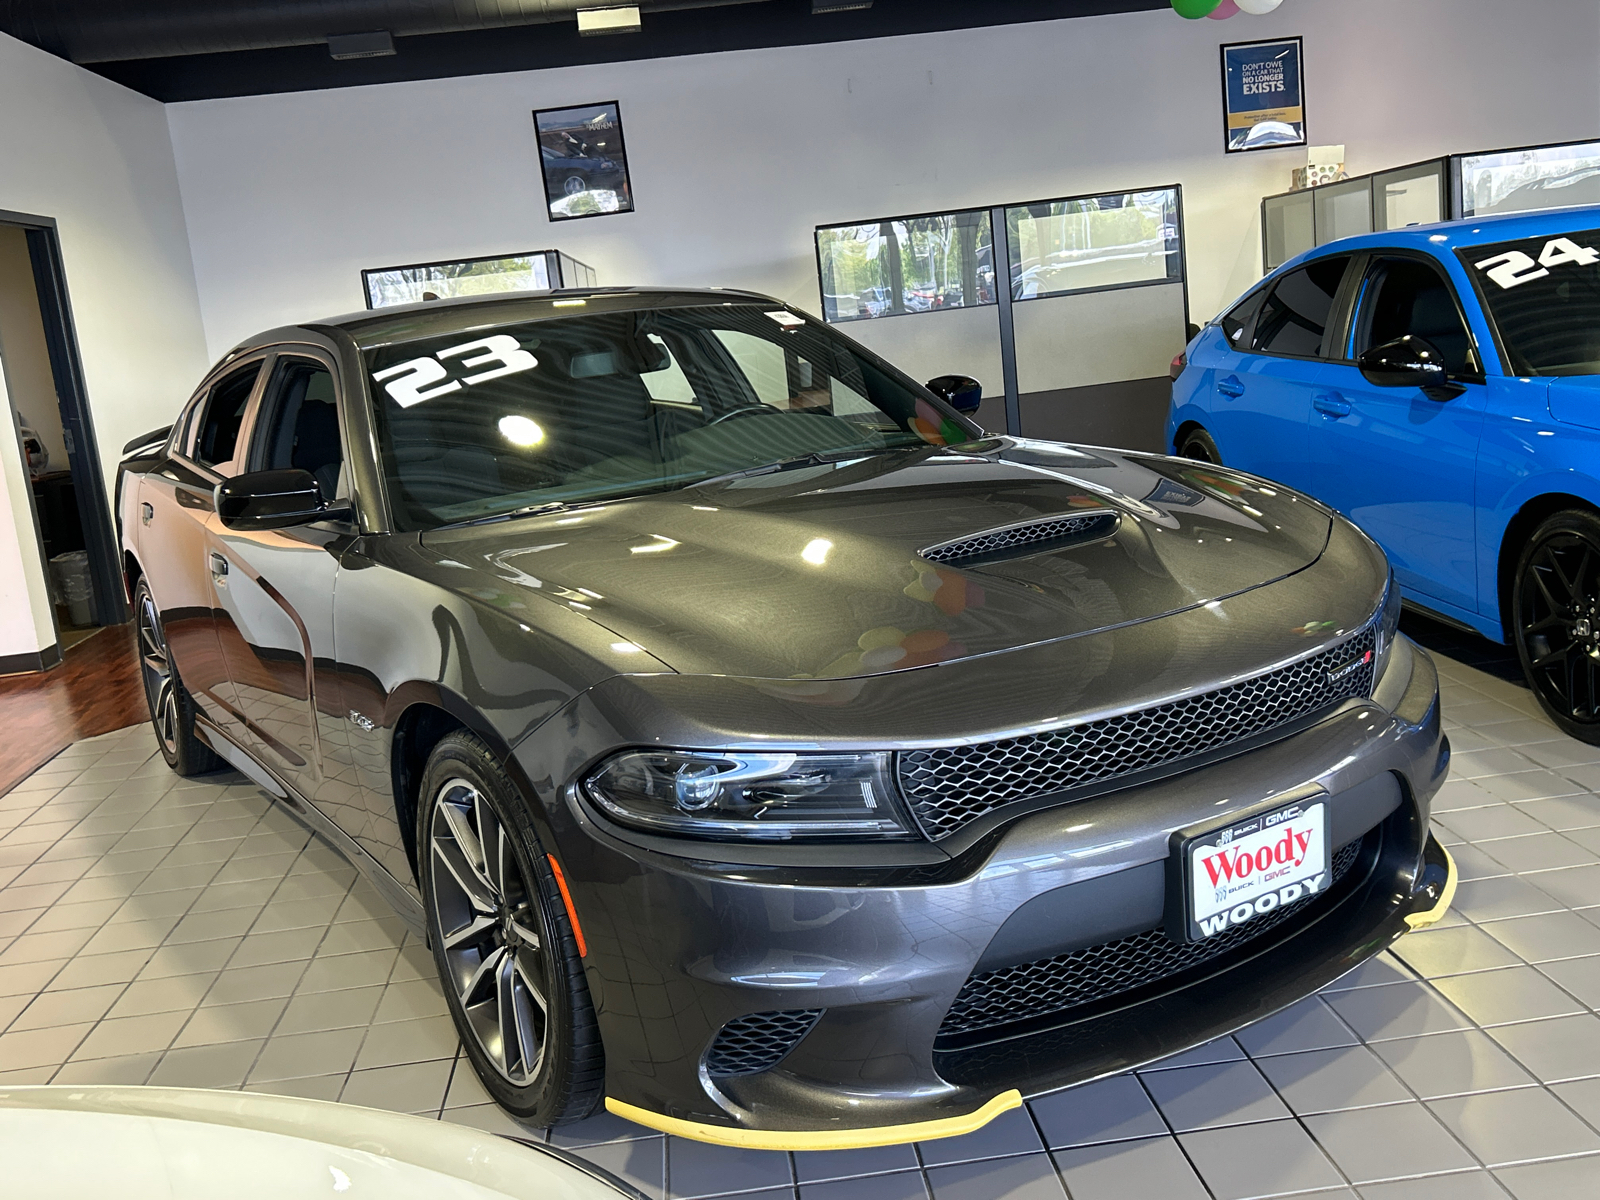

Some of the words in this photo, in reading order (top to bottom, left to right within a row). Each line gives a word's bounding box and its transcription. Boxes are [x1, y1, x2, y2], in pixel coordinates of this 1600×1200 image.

[1242, 62, 1264, 71] DON'T
[1265, 60, 1283, 69] OWE
[1242, 76, 1254, 84] NO
[1255, 73, 1284, 83] LONGER
[1243, 80, 1286, 95] EXISTS.
[1474, 237, 1600, 290] 24
[372, 334, 538, 409] 23
[1234, 823, 1258, 836] BUICK
[1265, 806, 1299, 826] GMC
[1201, 827, 1313, 888] Woody
[1228, 880, 1254, 894] BUICK
[1264, 866, 1291, 883] GMC
[1199, 873, 1325, 937] WOODY
